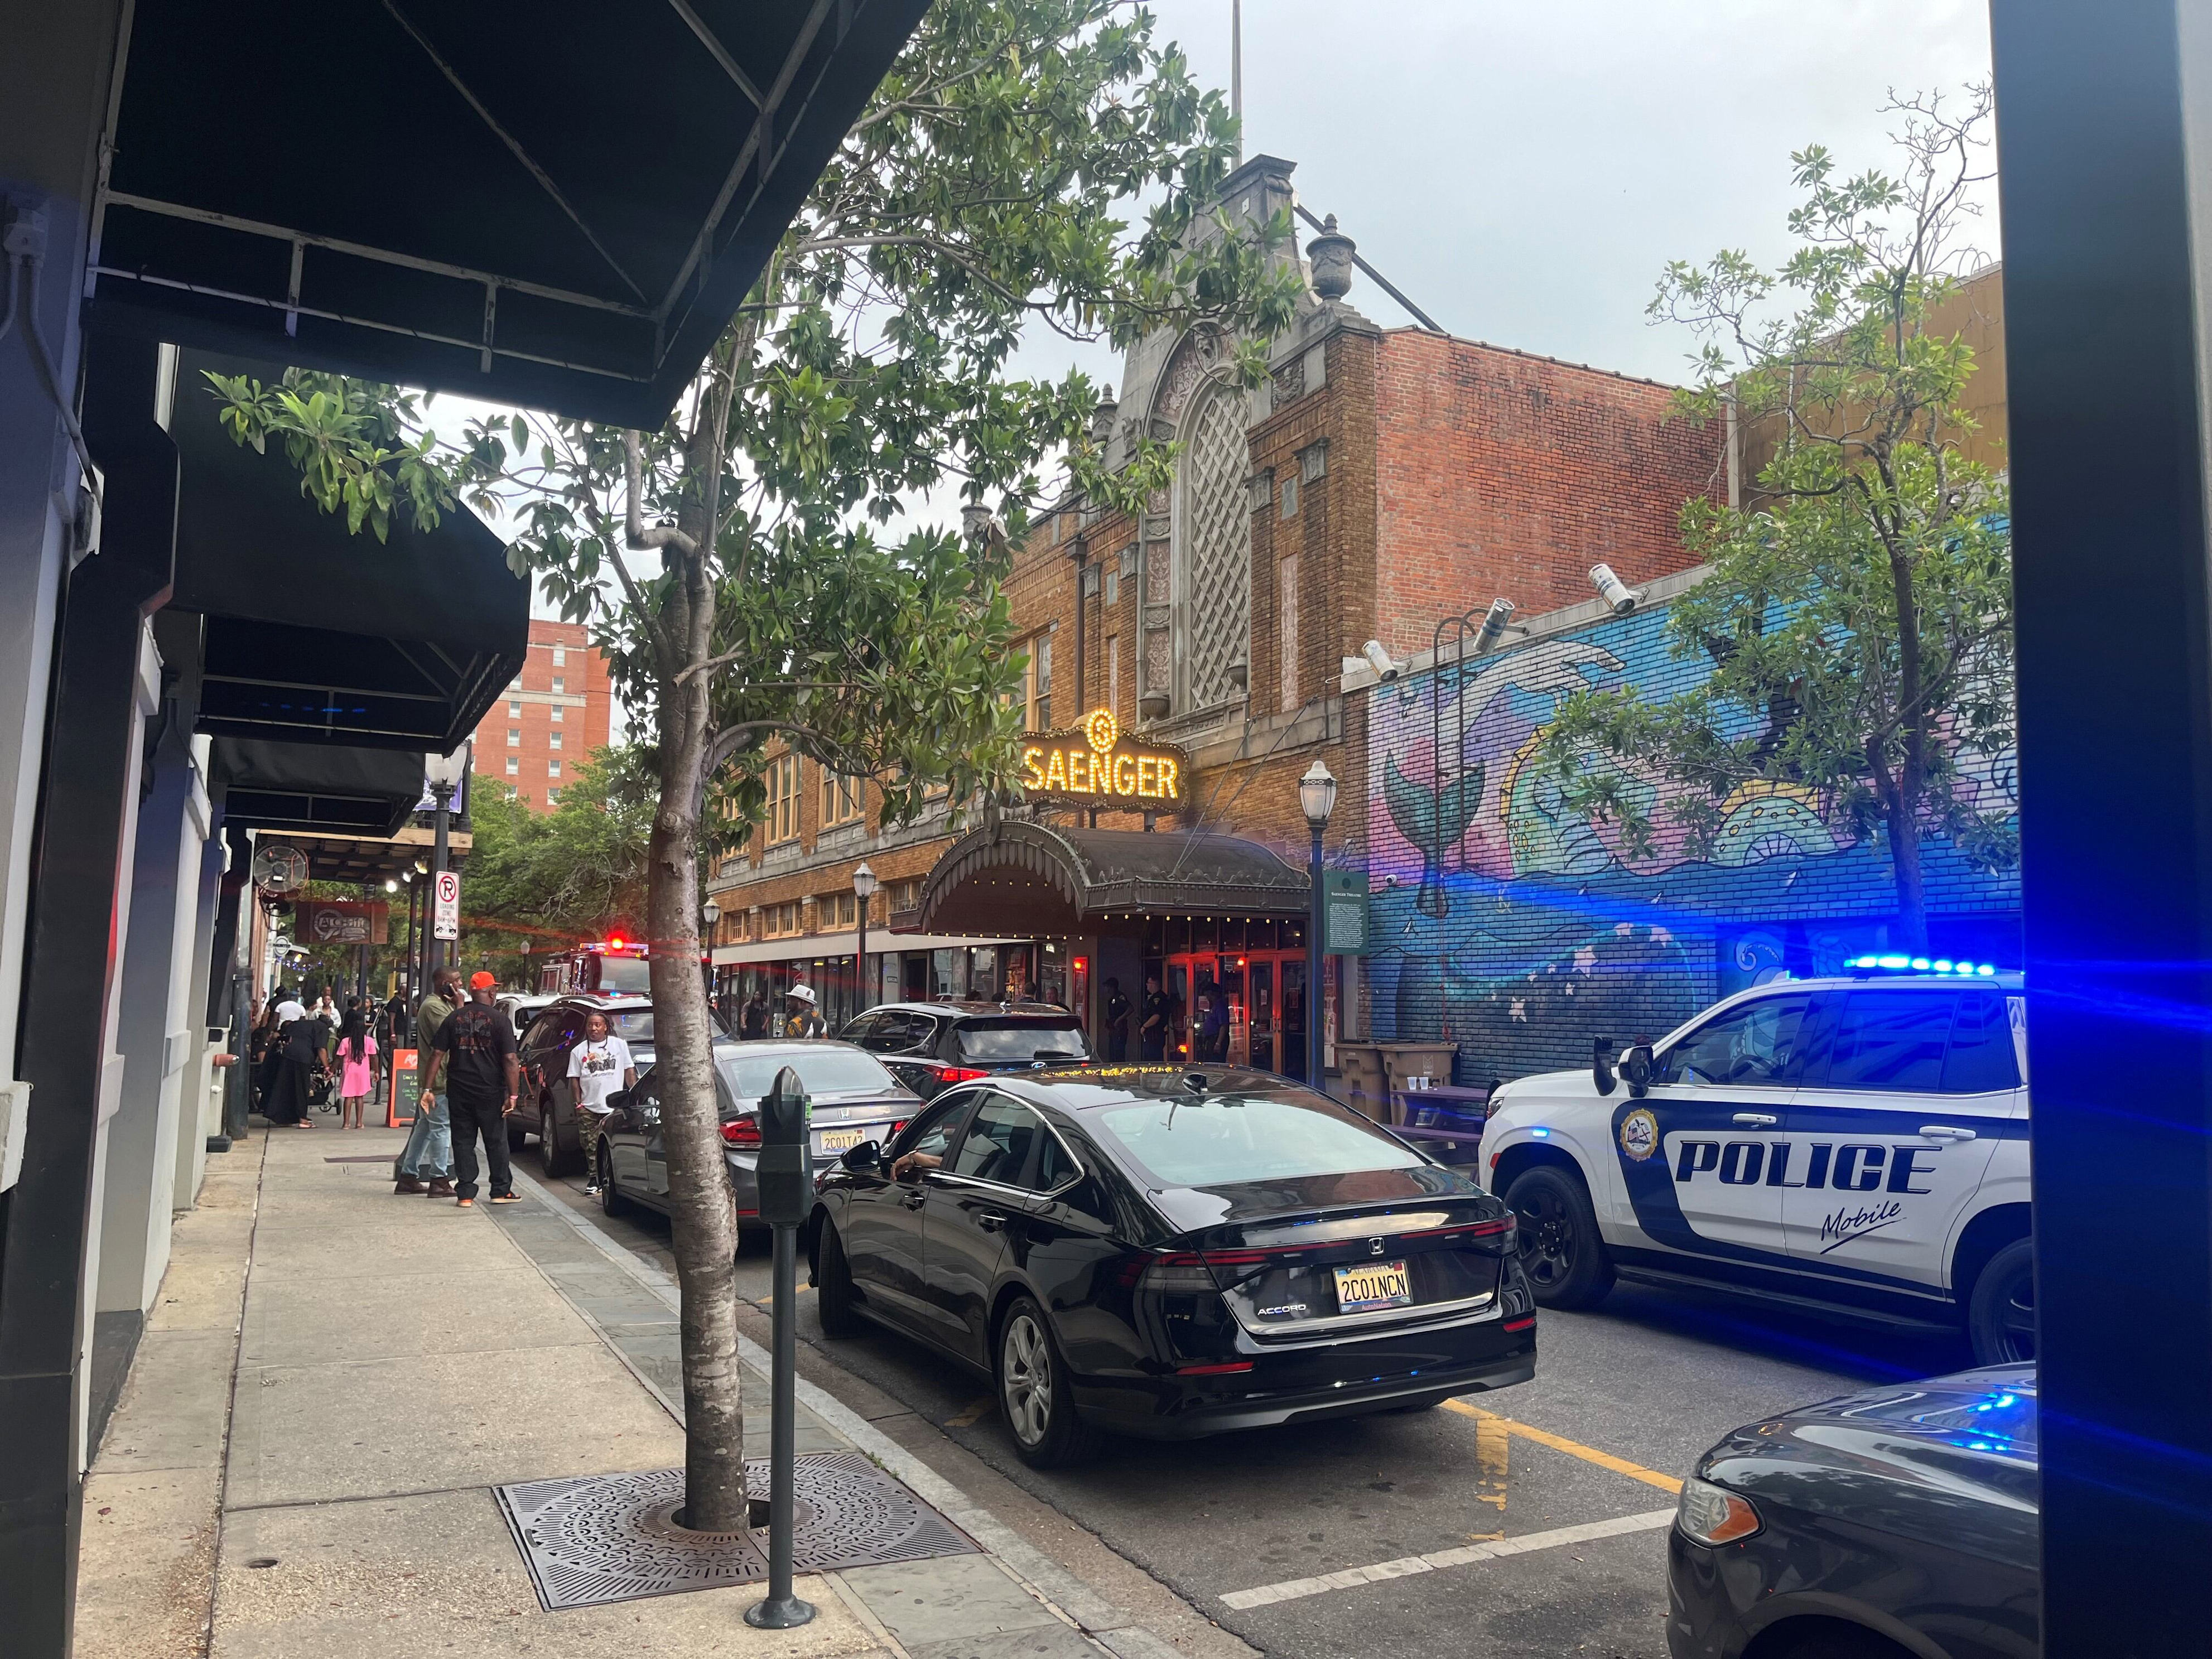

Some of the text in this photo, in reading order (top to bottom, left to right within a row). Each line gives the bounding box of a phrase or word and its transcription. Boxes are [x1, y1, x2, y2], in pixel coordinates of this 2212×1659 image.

[1023, 746, 1178, 799] SAENGER
[1675, 1140, 1943, 1195] POLICE
[1821, 1200, 1902, 1241] Mobile
[1342, 1274, 1406, 1303] 2C01NCN
[1257, 1304, 1307, 1316] ACCORD
[1362, 1302, 1392, 1311] AutoNation
